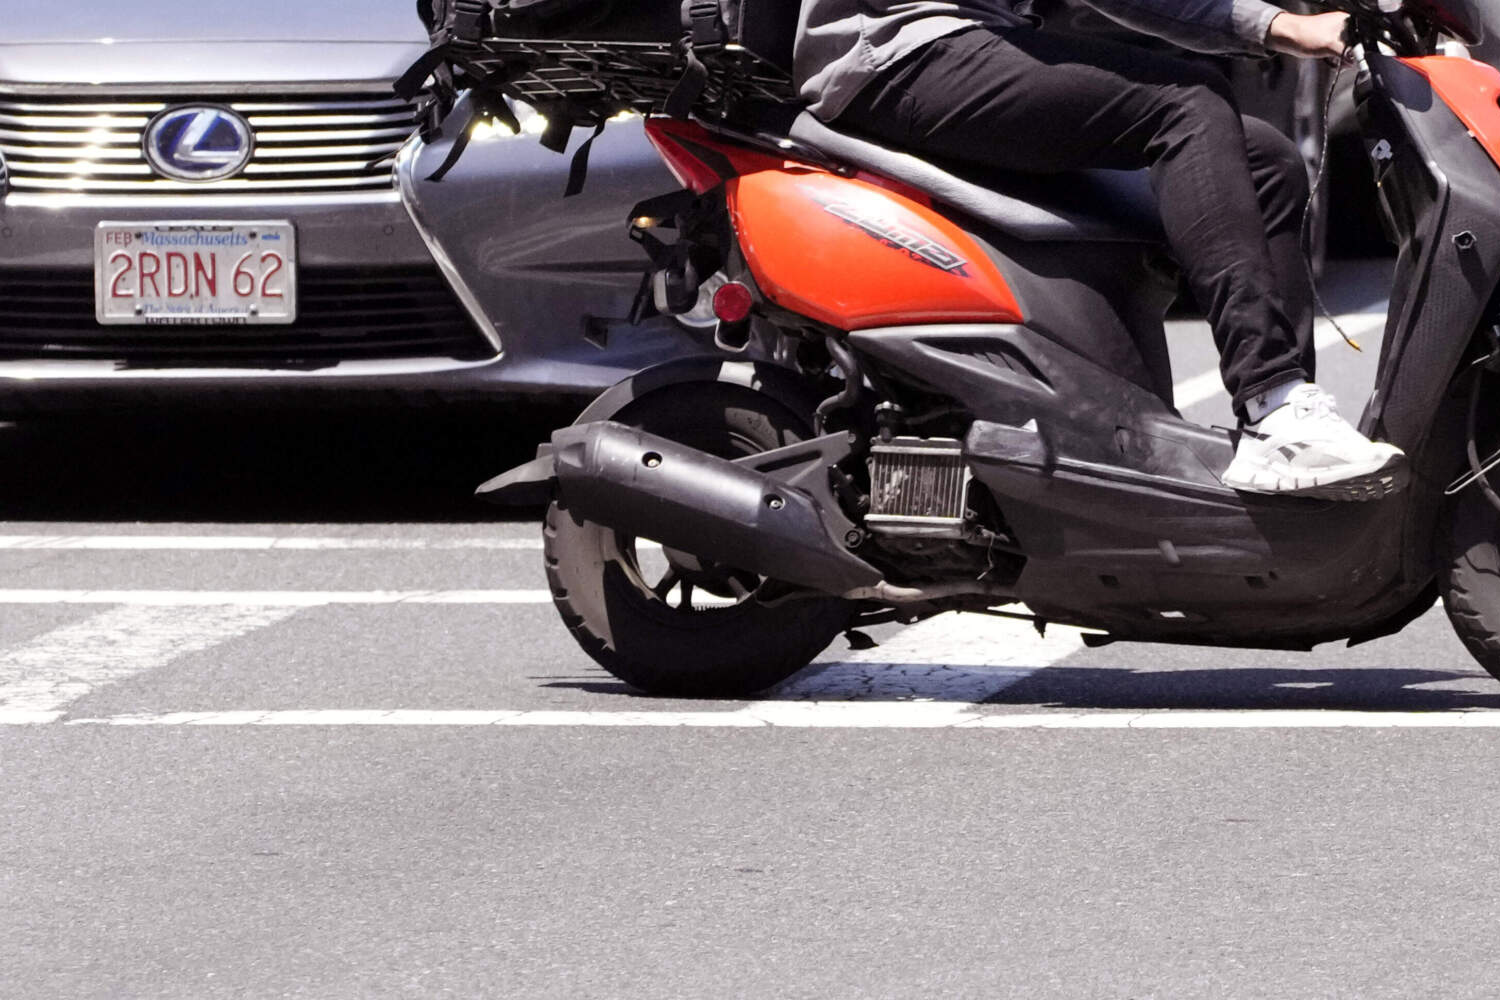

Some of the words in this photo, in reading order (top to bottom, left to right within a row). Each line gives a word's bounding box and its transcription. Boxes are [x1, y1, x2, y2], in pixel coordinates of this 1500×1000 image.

[106, 231, 132, 247] FEB
[141, 231, 248, 247] Massachusetts
[109, 251, 217, 298] 2RDN
[231, 251, 284, 298] 62
